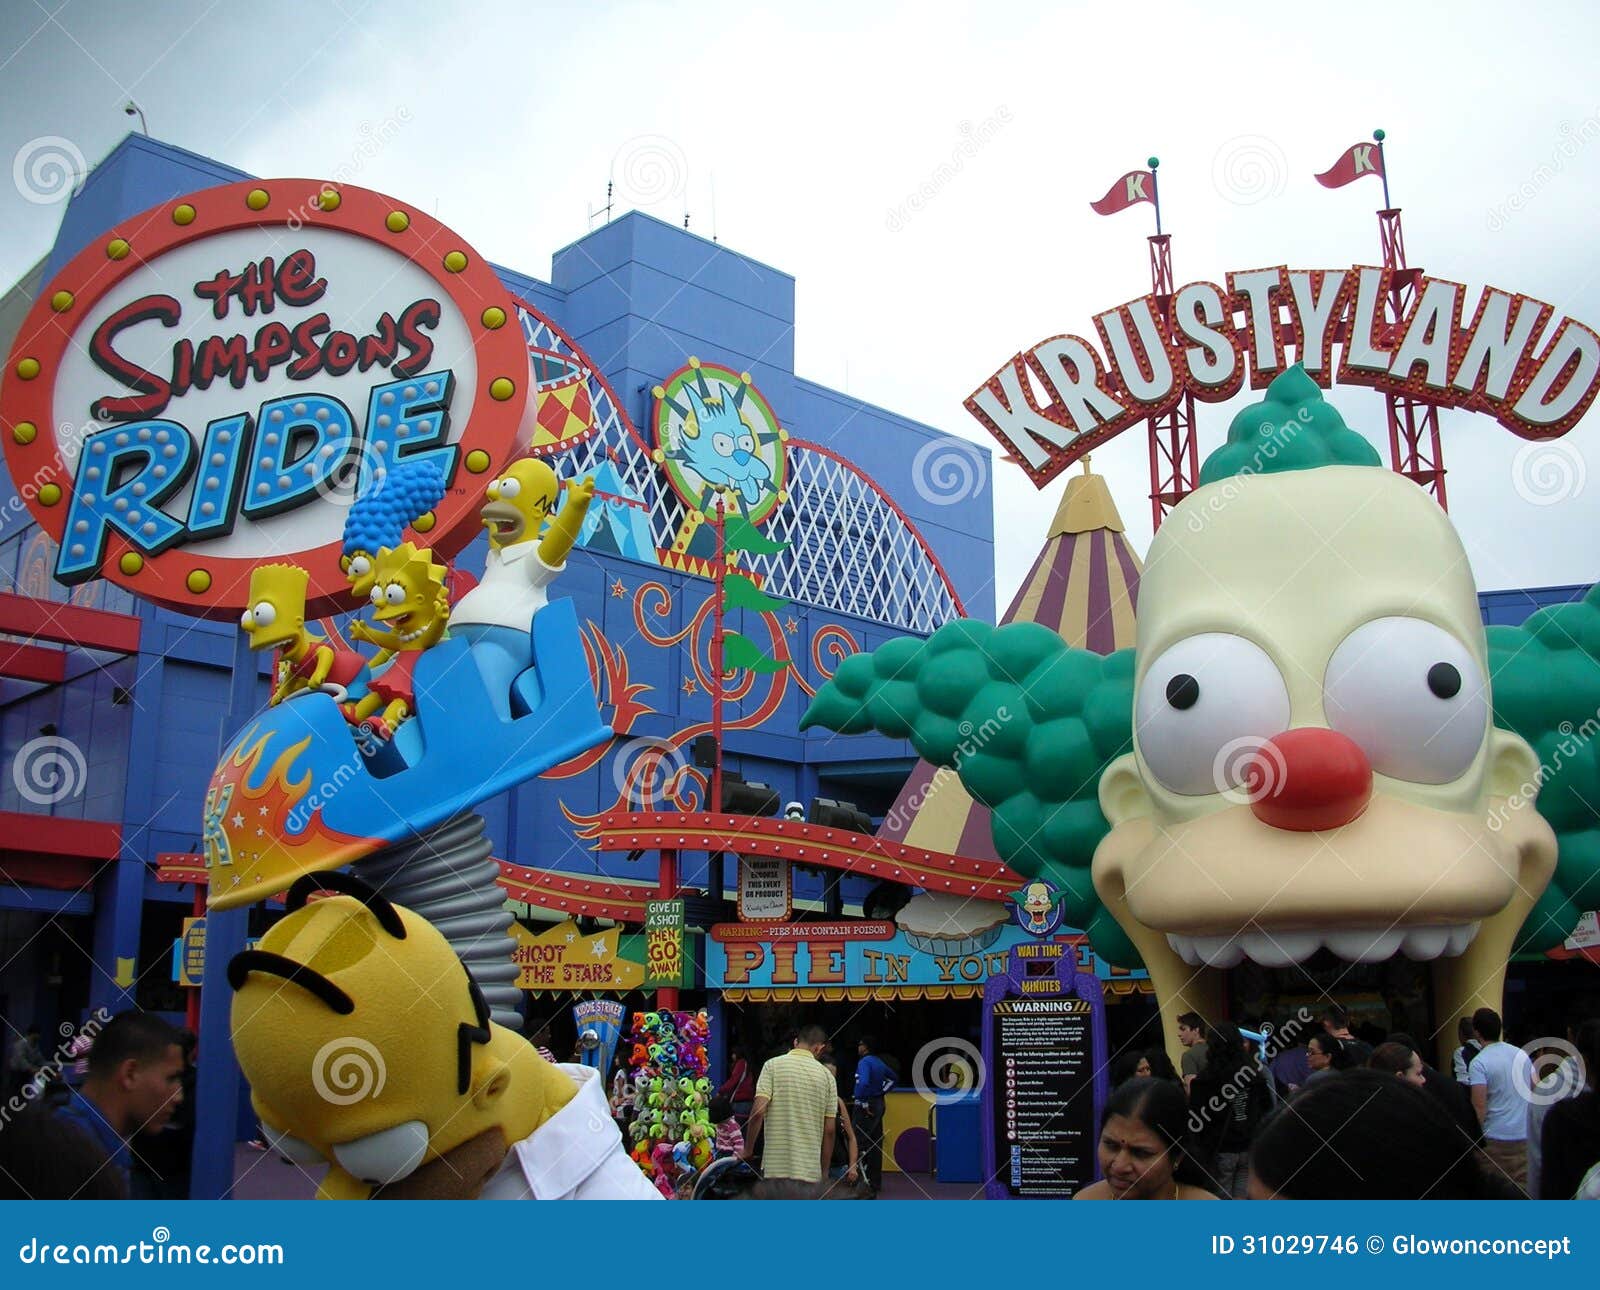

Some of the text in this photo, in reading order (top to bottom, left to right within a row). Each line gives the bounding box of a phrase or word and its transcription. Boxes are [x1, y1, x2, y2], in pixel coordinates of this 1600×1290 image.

[1353, 145, 1379, 173] K
[1126, 174, 1148, 201] K
[967, 265, 1600, 478] KRUSTYLAND
[55, 369, 461, 586] RIDE
[755, 890, 783, 898] PRODUCT
[649, 902, 680, 913] GIVE IT
[649, 914, 680, 925] A SHOT
[649, 930, 676, 942] THEN
[792, 926, 810, 937] MAY
[812, 926, 851, 936] CONTAIN
[853, 925, 887, 935] POISON
[650, 941, 678, 961] GO
[1017, 945, 1063, 957] WAIT TIME
[650, 961, 681, 975] AWAY!
[723, 942, 846, 984] PIE
[863, 949, 911, 983] IN
[934, 953, 1009, 982] YOU
[522, 963, 613, 983] THE STARS
[1021, 980, 1061, 993] MINUTES
[1012, 1002, 1073, 1012] WARNING
